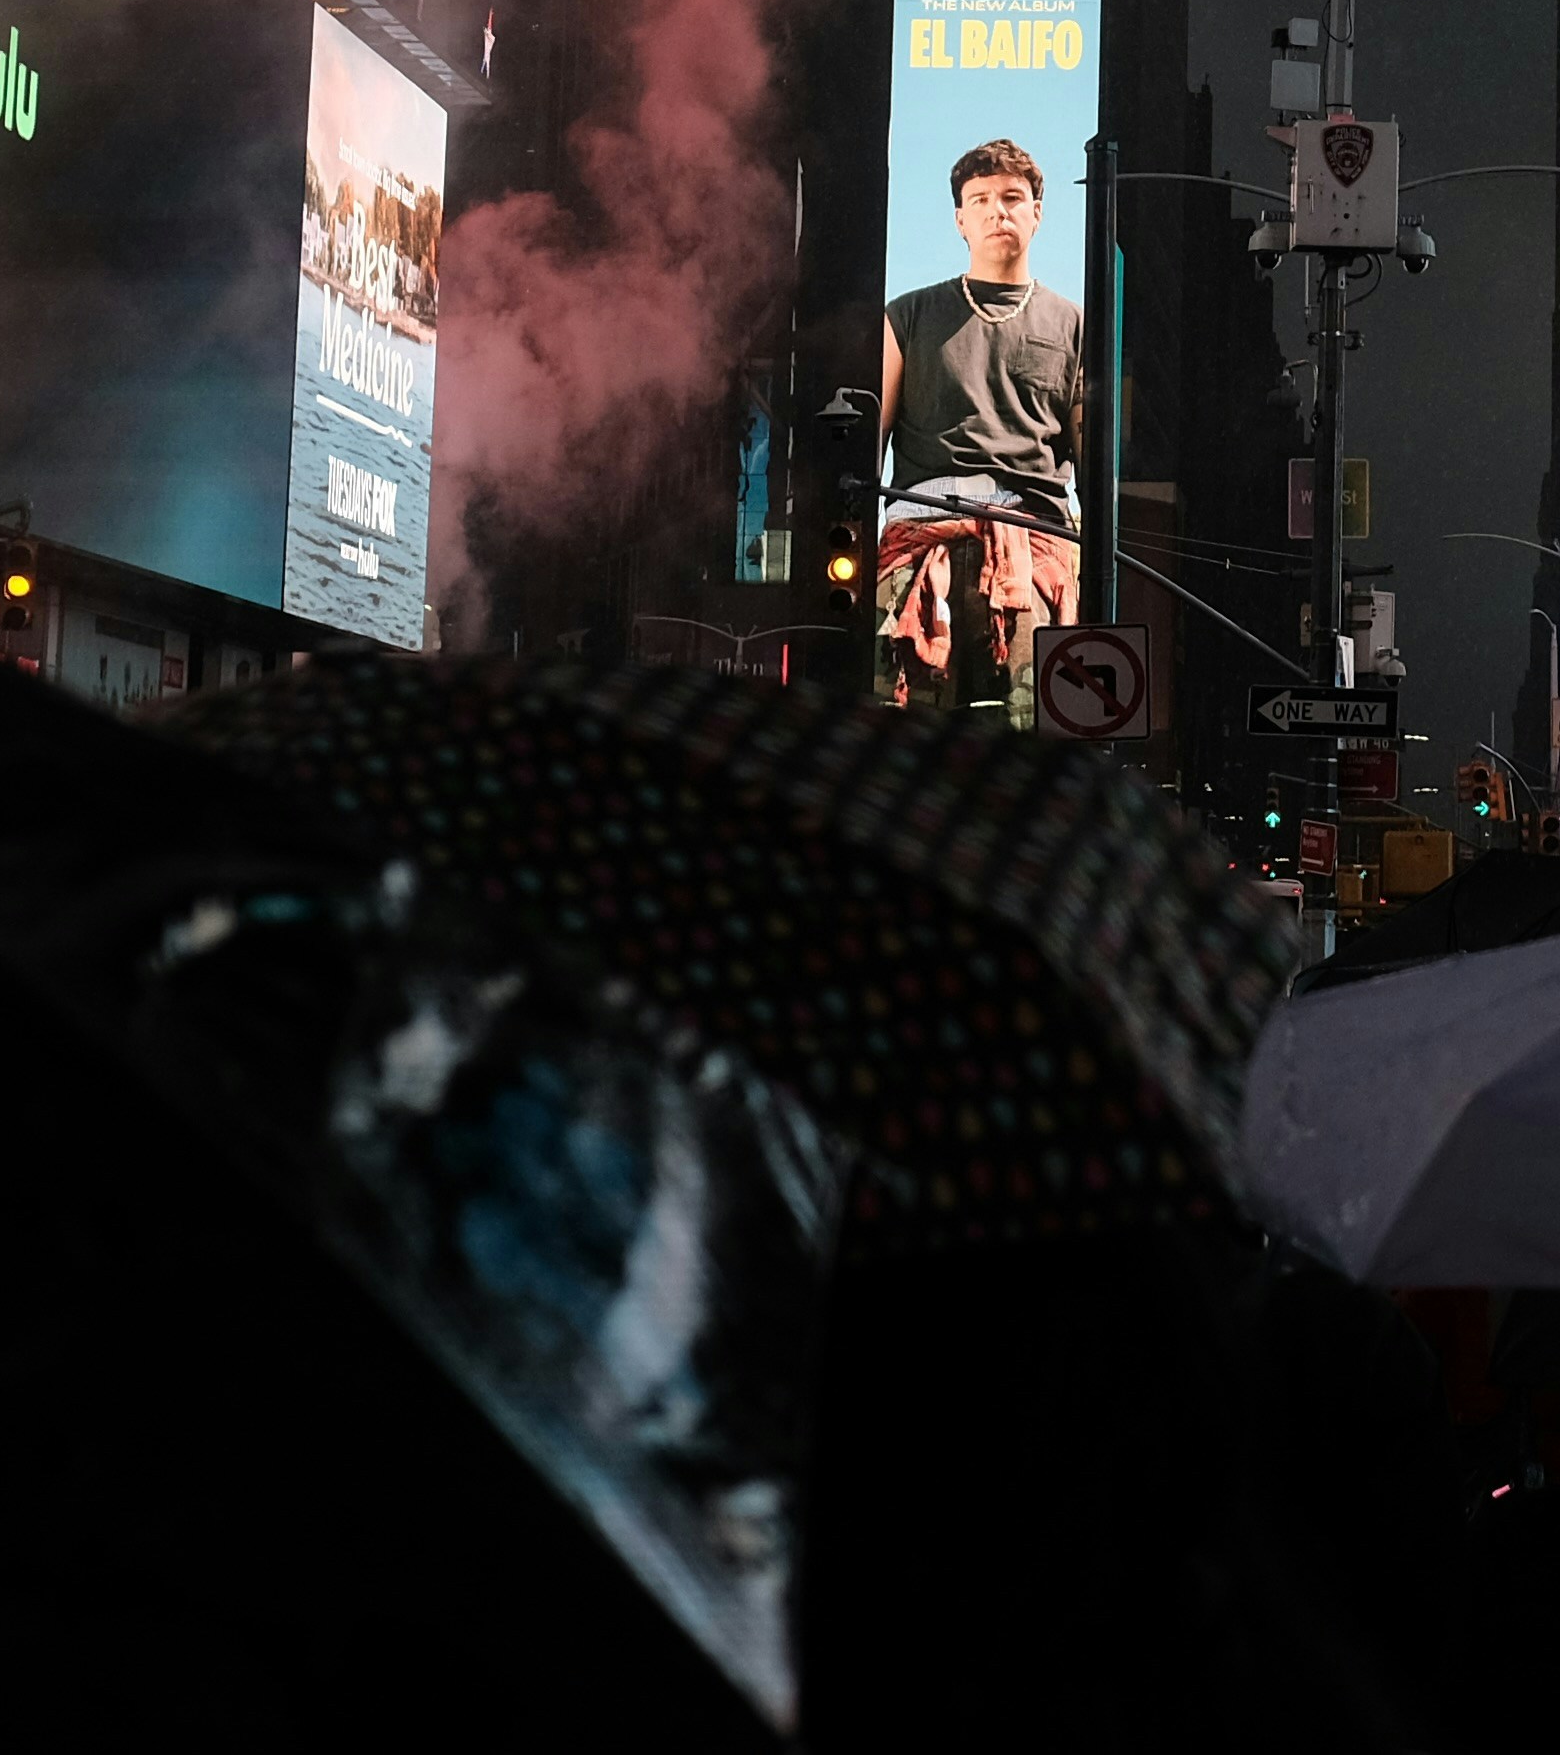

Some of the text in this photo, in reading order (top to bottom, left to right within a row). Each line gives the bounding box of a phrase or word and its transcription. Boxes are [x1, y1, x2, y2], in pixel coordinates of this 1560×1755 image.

[922, 0, 1075, 12] THE NEW ALBUM
[910, 19, 1083, 70] EL BAIFO
[349, 200, 397, 313] Best
[319, 284, 414, 417] Medicine
[327, 454, 398, 537] TUESDAYS FOX
[1271, 701, 1379, 724] ONE WAY
